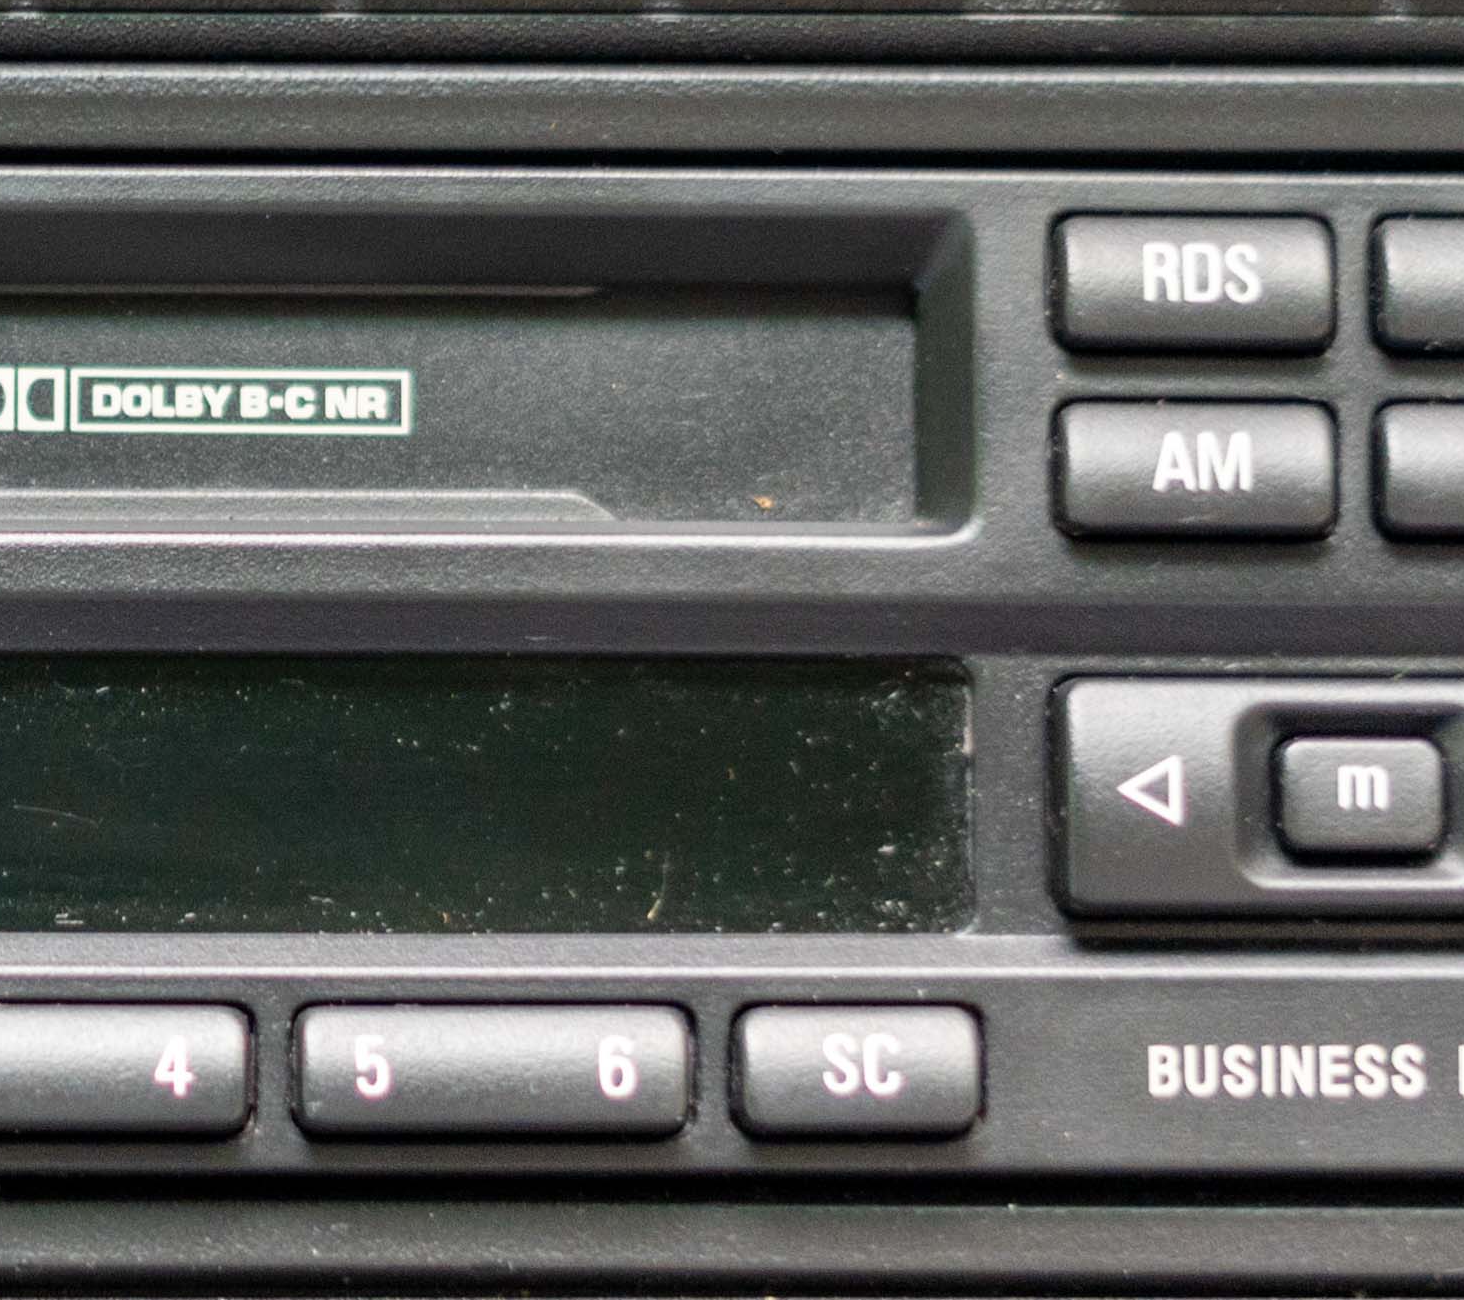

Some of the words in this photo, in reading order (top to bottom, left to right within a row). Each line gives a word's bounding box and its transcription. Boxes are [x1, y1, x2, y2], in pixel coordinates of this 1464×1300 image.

[1142, 242, 1262, 304] RDS
[91, 383, 232, 419] DOLBY
[323, 385, 389, 420] NR
[1151, 431, 1253, 493] AM
[154, 1038, 195, 1097] 4
[353, 1037, 392, 1097] 5
[596, 1038, 638, 1097] 6
[820, 1035, 904, 1095] SC
[1147, 1042, 1426, 1099] BUSINESS
